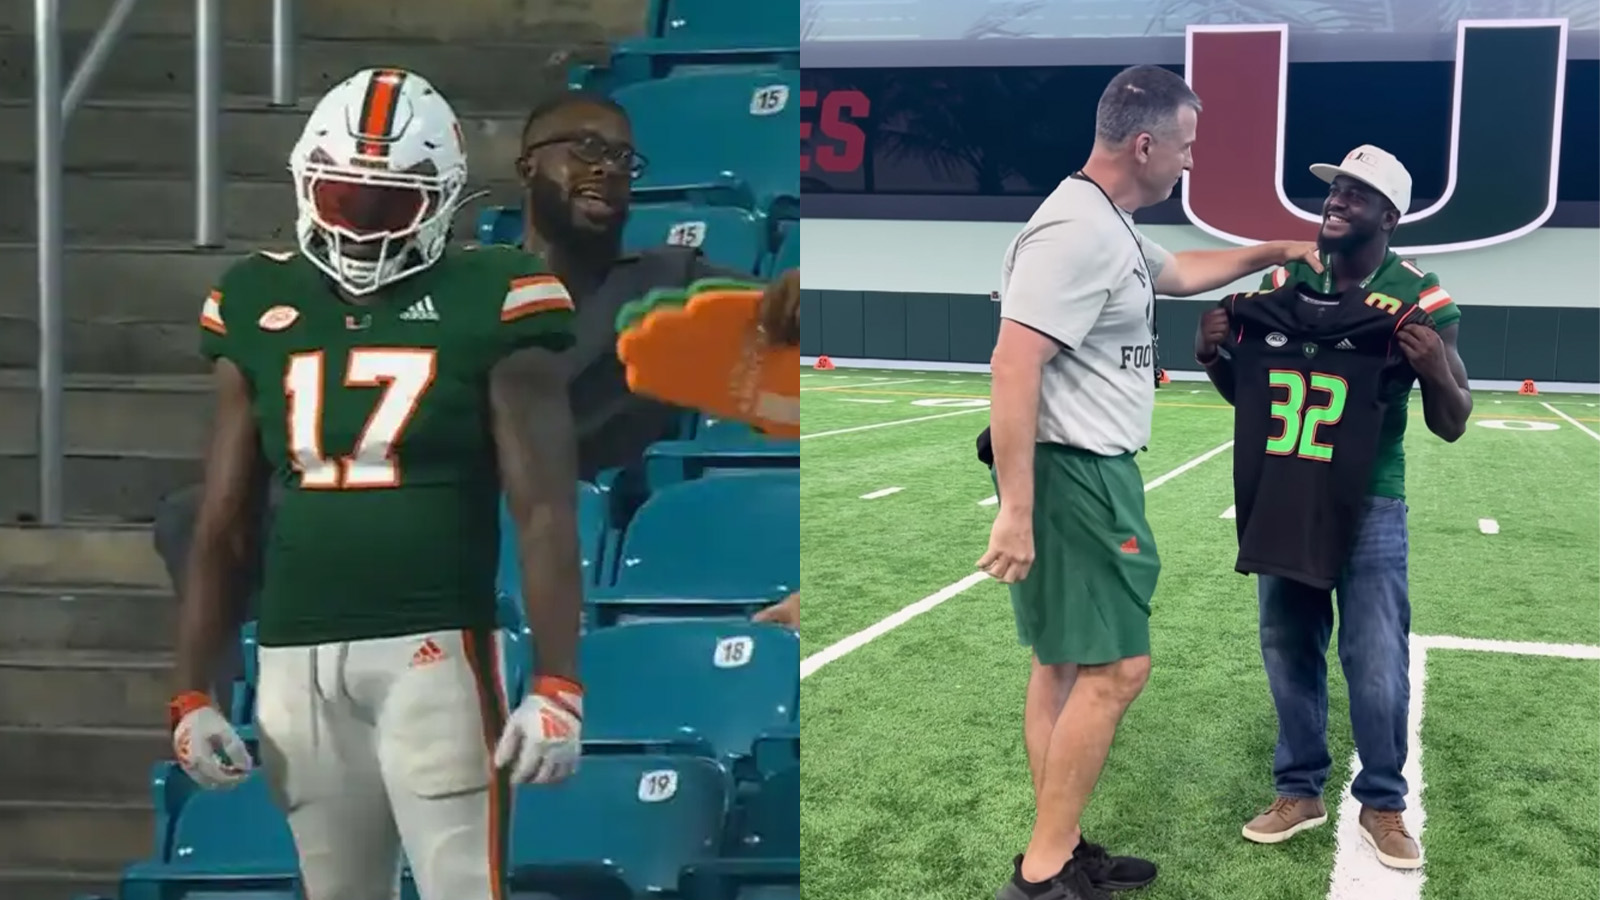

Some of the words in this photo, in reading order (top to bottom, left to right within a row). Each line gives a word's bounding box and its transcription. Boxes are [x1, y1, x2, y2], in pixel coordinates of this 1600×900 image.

[758, 90, 780, 109] 15
[1182, 19, 1569, 254] U
[677, 228, 697, 244] 15
[817, 358, 827, 368] 50
[1120, 346, 1151, 369] FOO
[1523, 382, 1534, 393] 30
[284, 347, 437, 488] 17
[1265, 369, 1349, 462] 32
[722, 642, 745, 662] 18
[648, 774, 670, 795] 19
